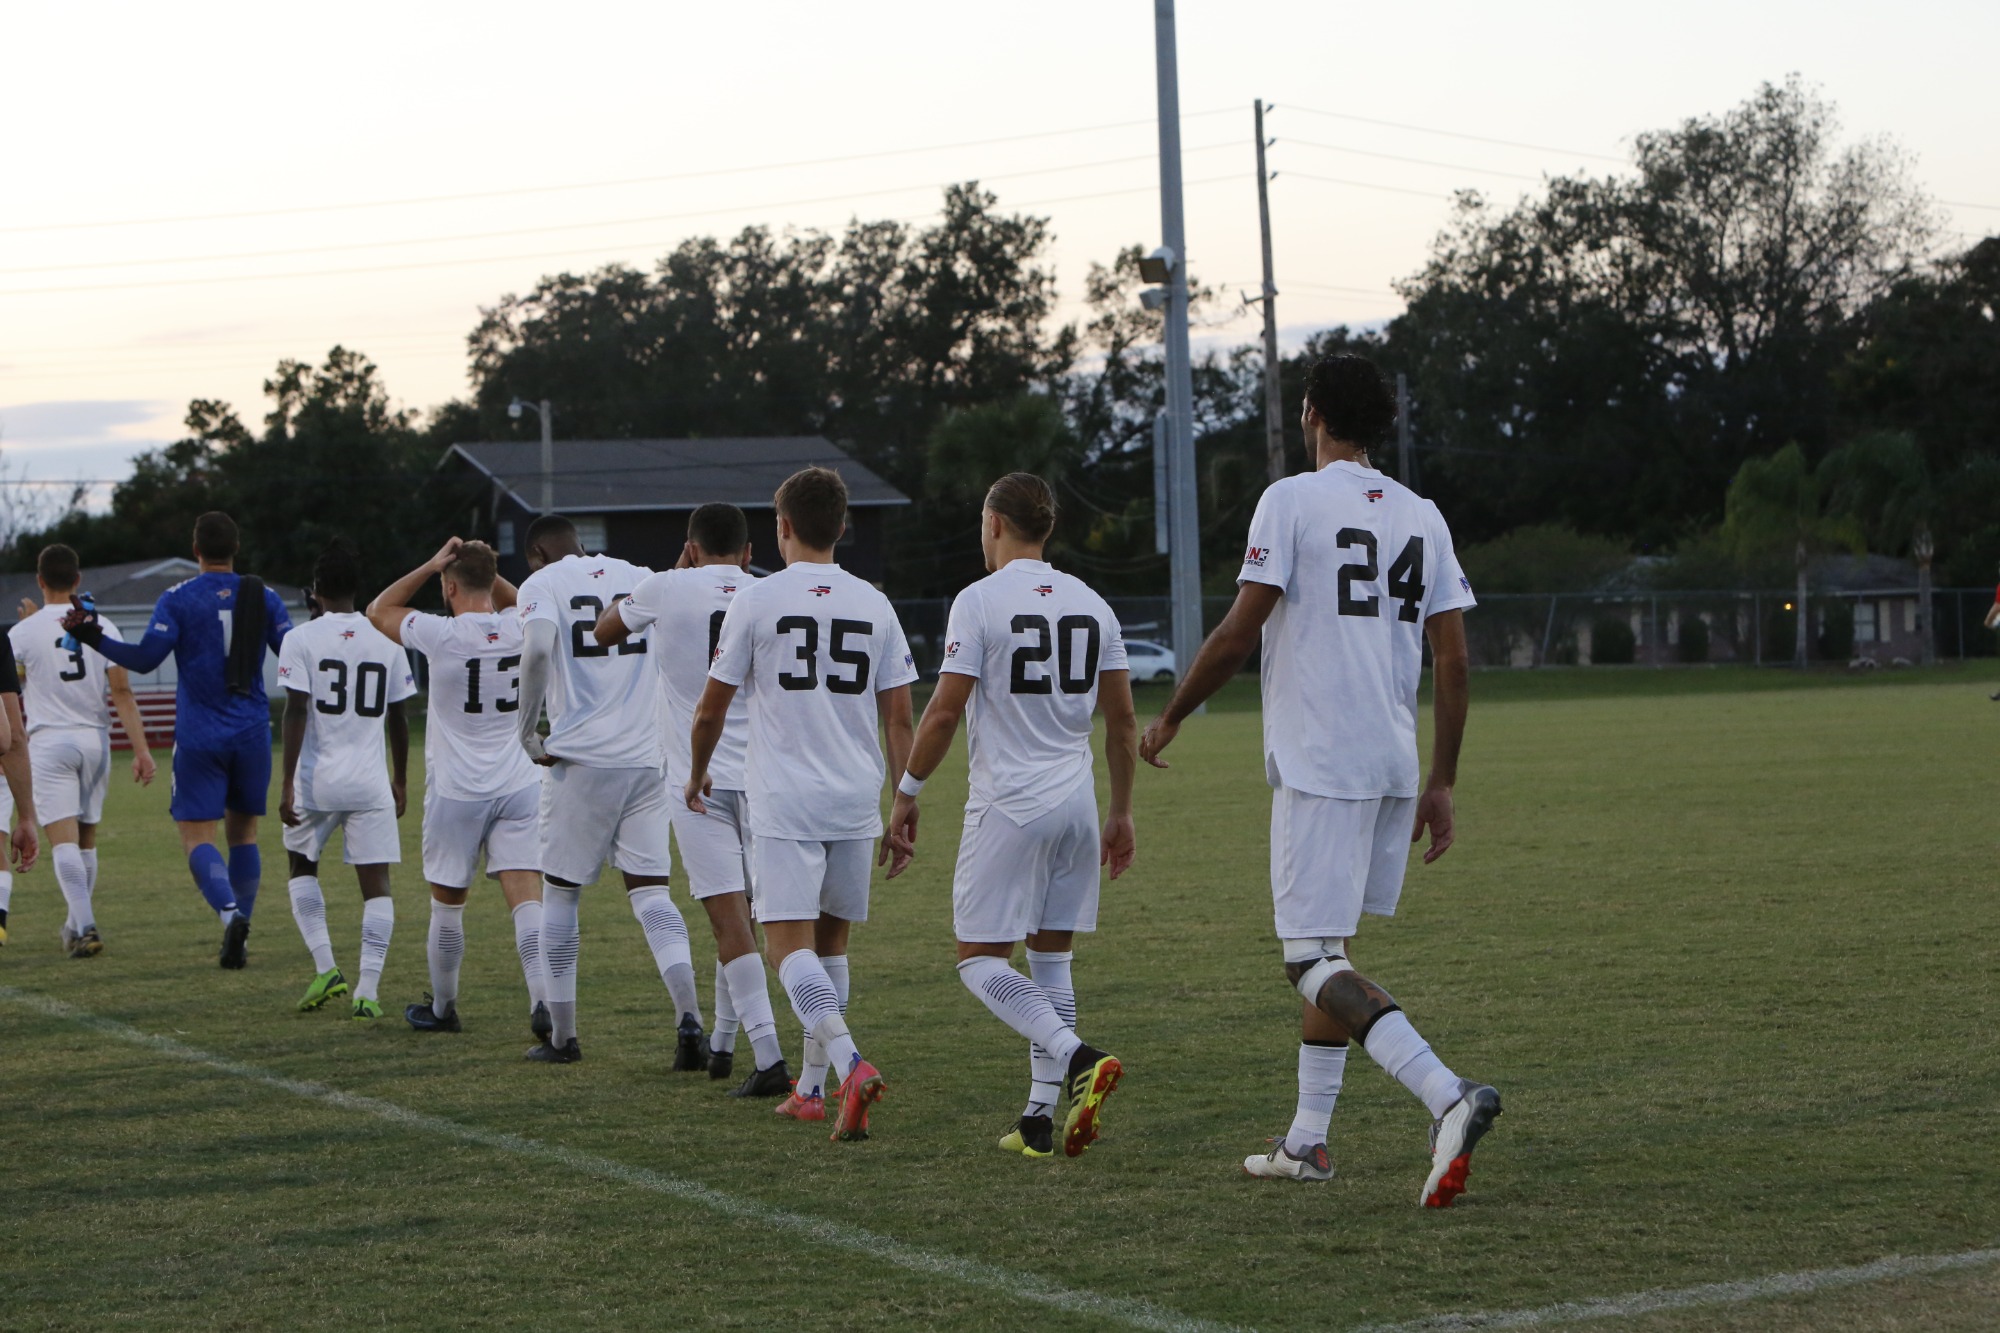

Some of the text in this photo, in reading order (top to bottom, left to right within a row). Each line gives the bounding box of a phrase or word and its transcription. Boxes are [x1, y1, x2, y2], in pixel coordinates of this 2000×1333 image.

[1336, 527, 1426, 624] 24
[55, 637, 86, 682] 3
[218, 609, 233, 657] 1
[776, 615, 873, 695] 35
[1010, 614, 1100, 694] 20
[315, 658, 387, 718] 30
[464, 653, 522, 713] 13
